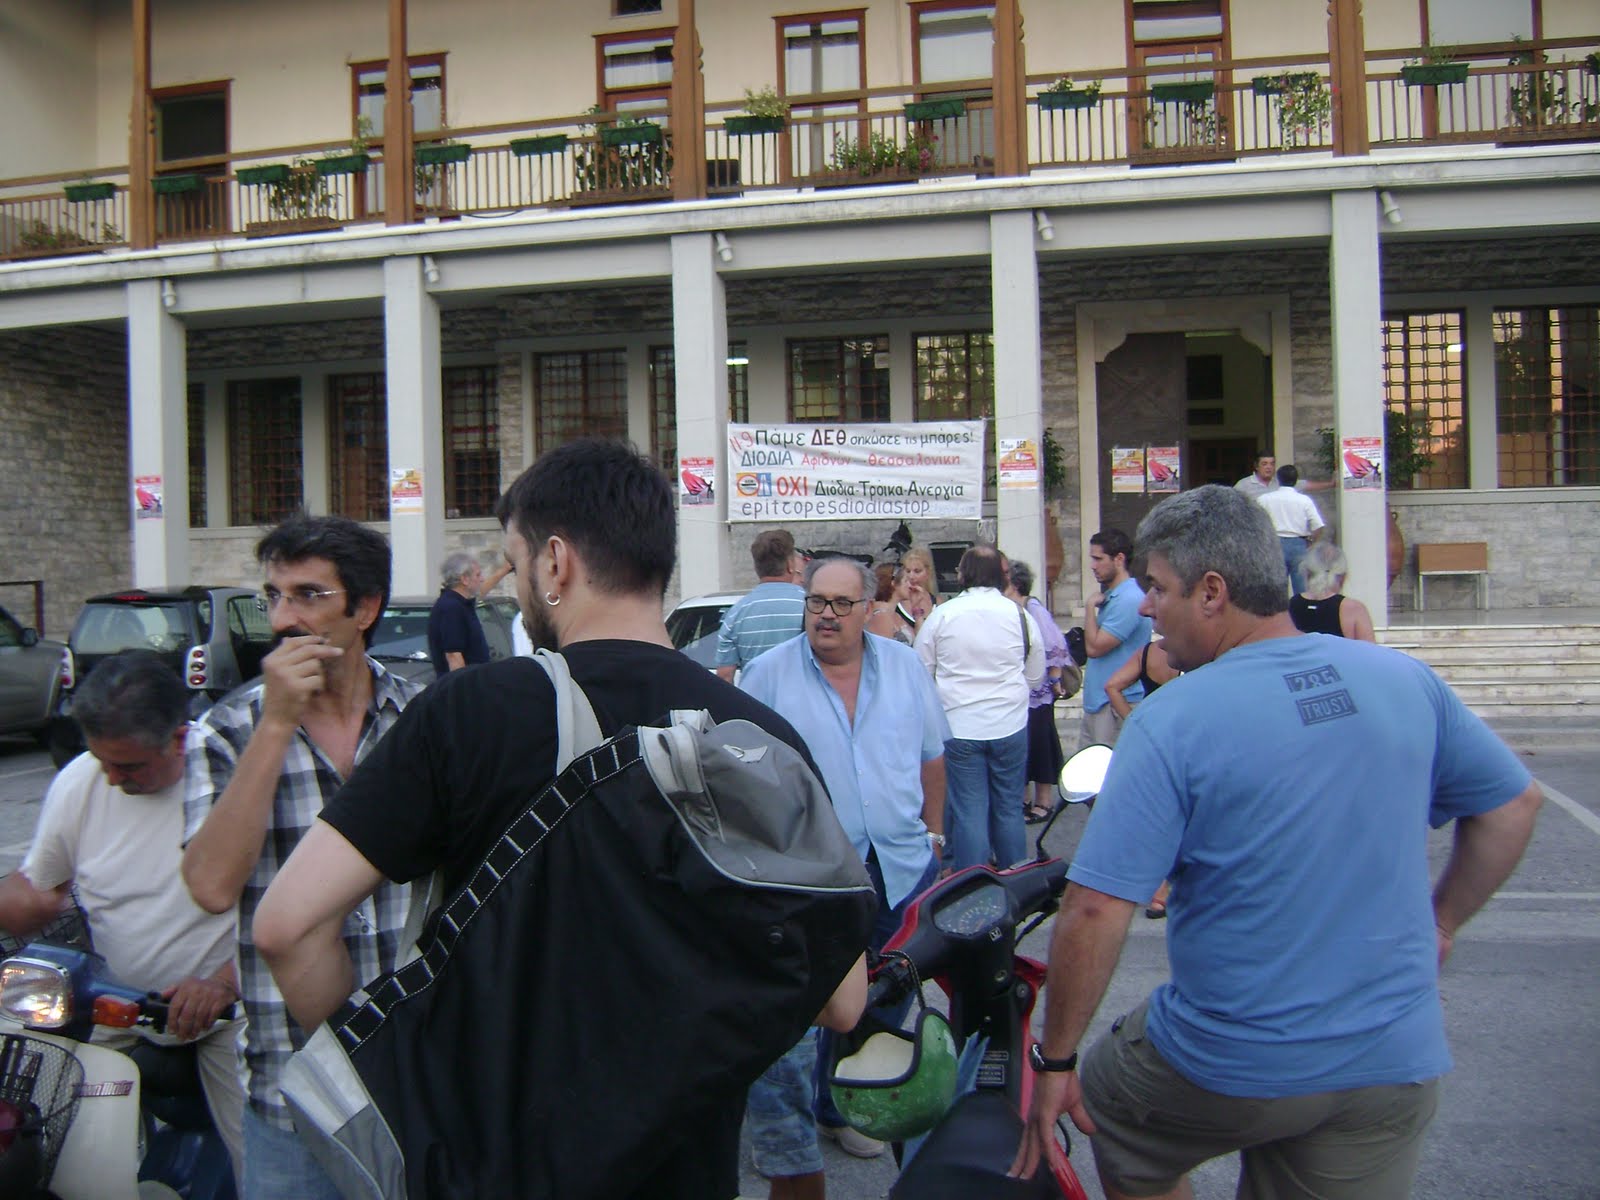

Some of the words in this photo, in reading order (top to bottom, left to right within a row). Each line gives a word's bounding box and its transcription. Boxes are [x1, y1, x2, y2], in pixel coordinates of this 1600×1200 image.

[755, 428, 806, 449] Πάμε
[811, 429, 847, 446] ΔΕΘ
[741, 450, 794, 467] ΔΙΟΔΙΑ
[776, 476, 810, 496] ΟΧΙ
[1302, 696, 1350, 719] TRUST
